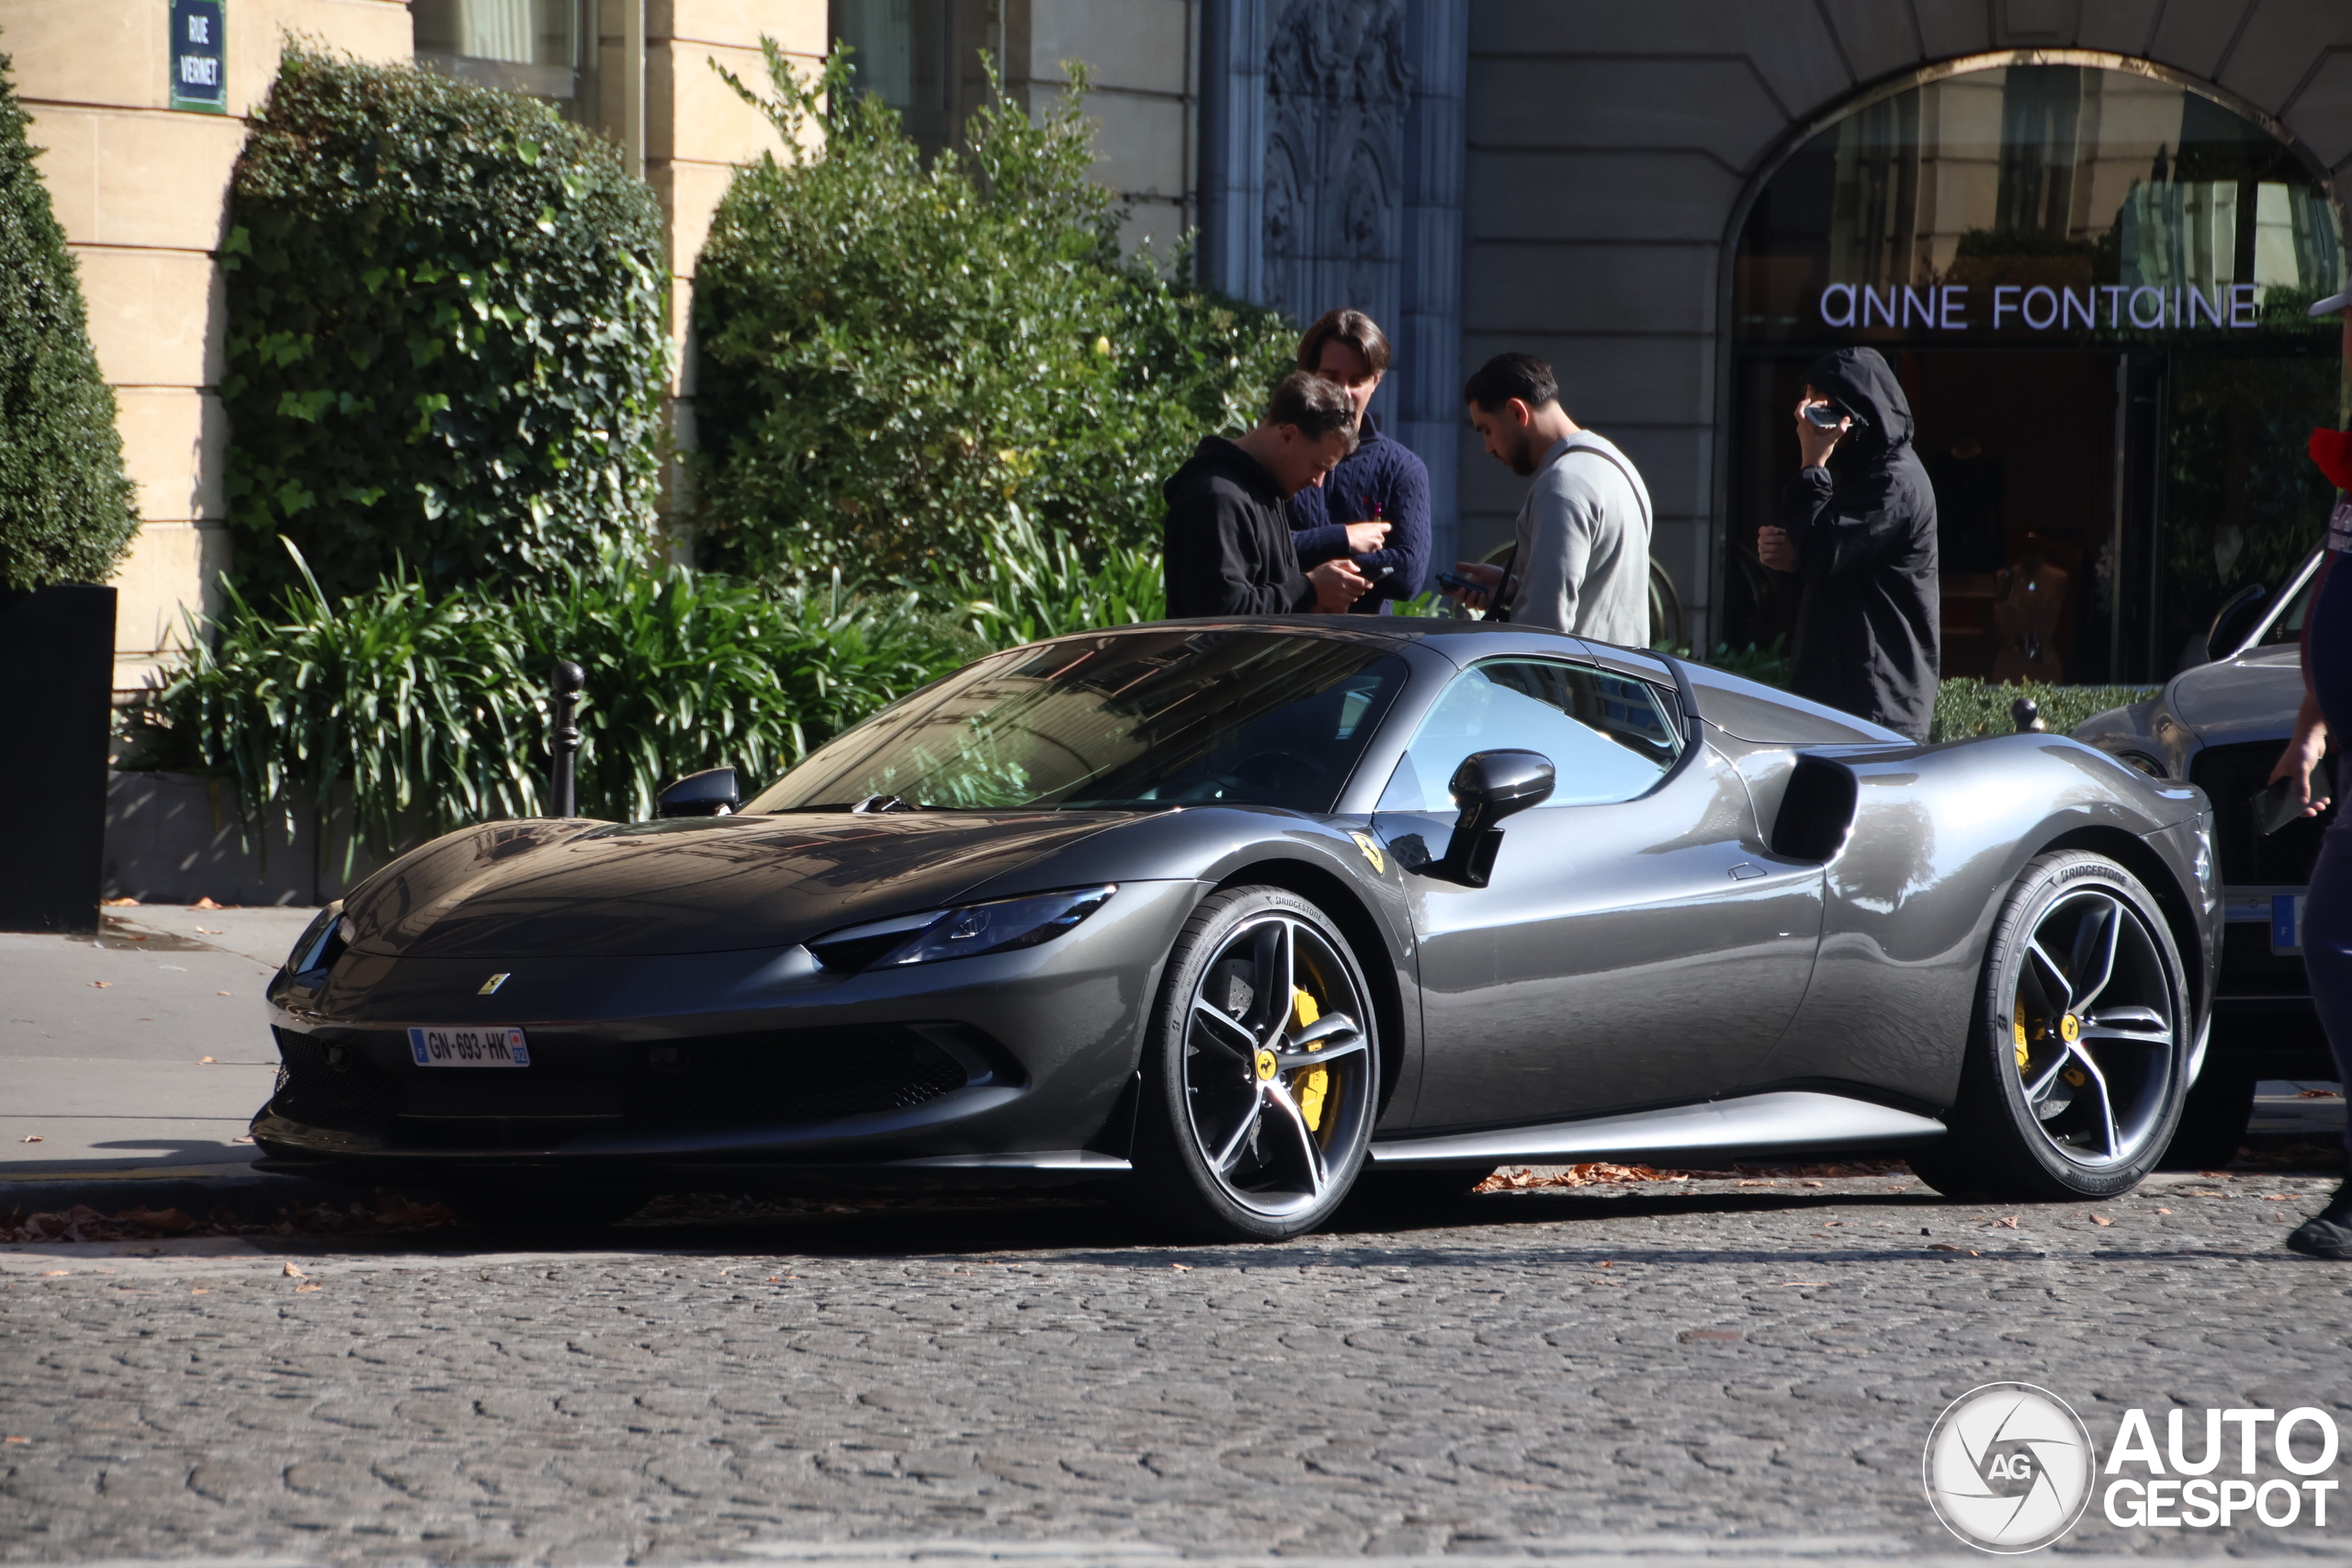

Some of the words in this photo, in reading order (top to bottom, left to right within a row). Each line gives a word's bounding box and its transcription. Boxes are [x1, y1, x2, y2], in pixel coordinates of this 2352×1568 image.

[188, 15, 209, 44] RUE
[180, 54, 218, 86] VERNET
[2061, 864, 2127, 886] BRIDGESTONE
[1275, 896, 1322, 921] BRIDGESTONE
[2281, 926, 2288, 937] F
[418, 1048, 424, 1058] F
[429, 1032, 511, 1060] GN-693-HK
[514, 1050, 527, 1062] 92
